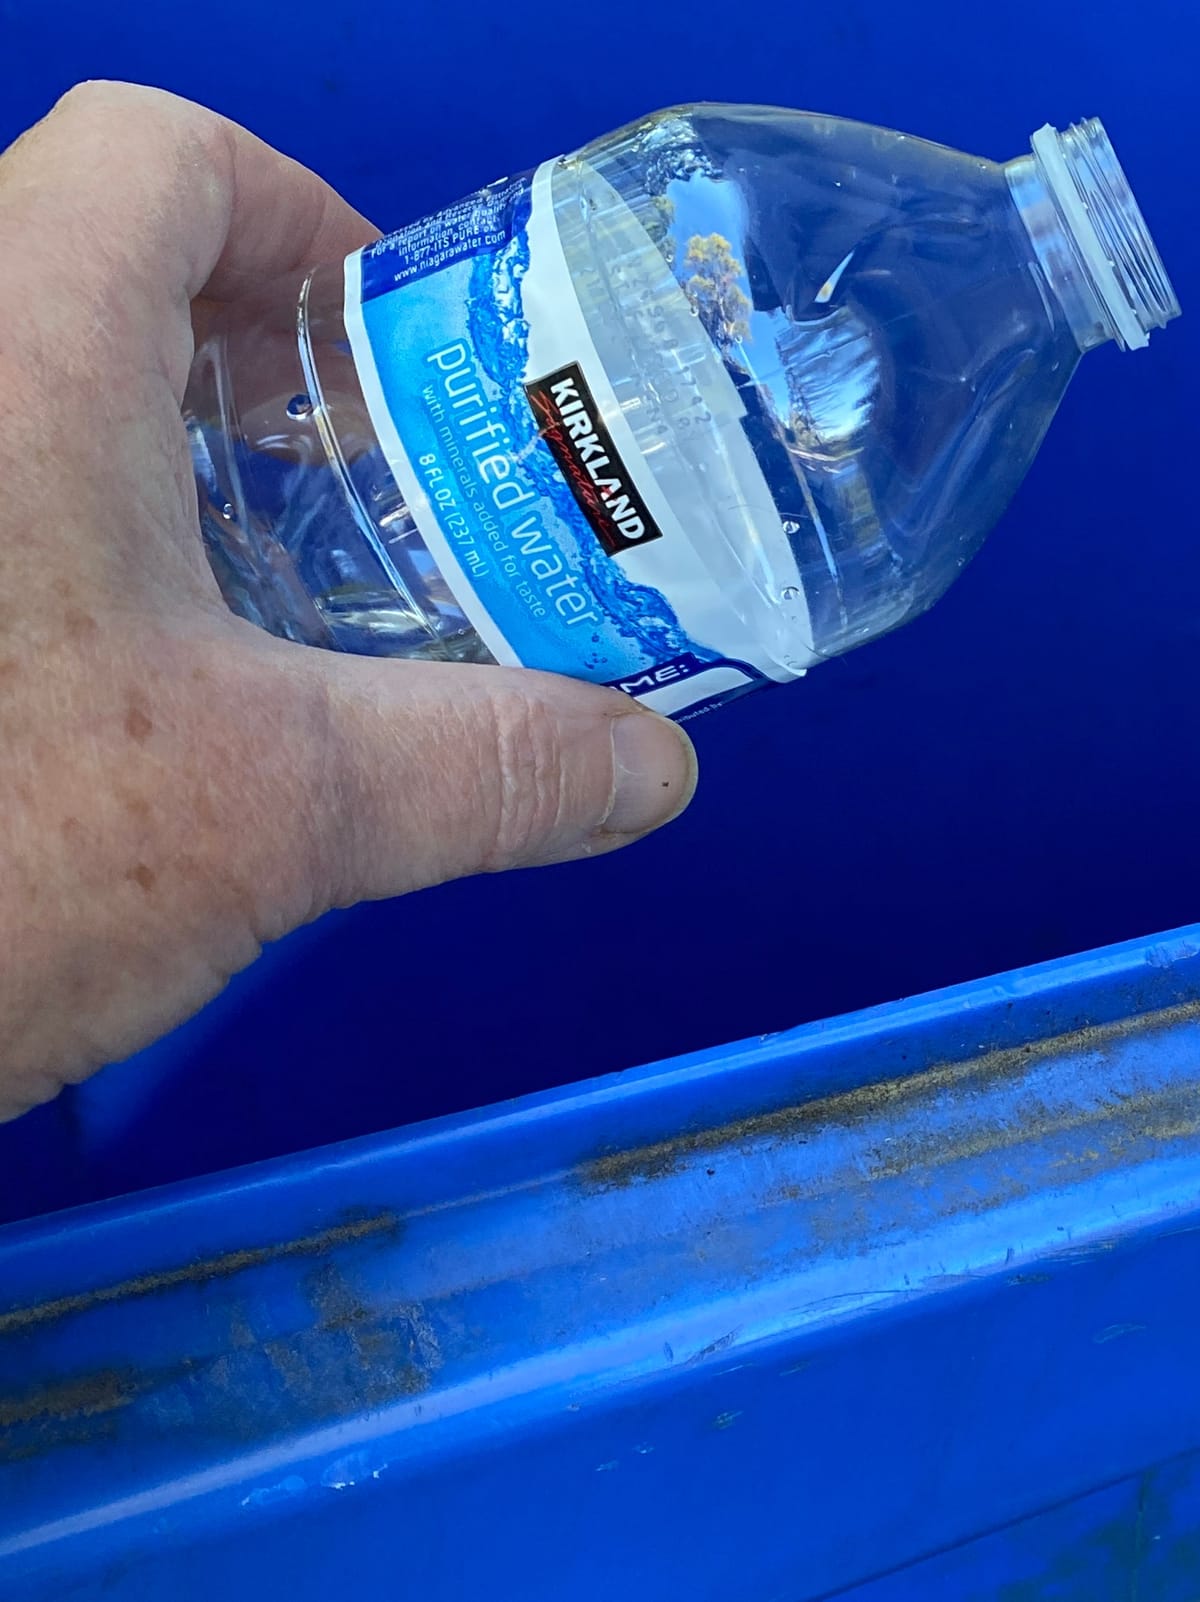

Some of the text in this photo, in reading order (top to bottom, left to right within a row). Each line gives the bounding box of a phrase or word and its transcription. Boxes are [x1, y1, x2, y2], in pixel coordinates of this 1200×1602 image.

[371, 244, 387, 259] For
[398, 229, 427, 246] report
[429, 224, 442, 234] on
[445, 212, 472, 228] water
[452, 225, 479, 243] PURE
[418, 453, 490, 579] 8 FL OZ (237 mL)
[422, 384, 546, 618] with minerals added for taste
[427, 343, 598, 624] purified water
[550, 377, 645, 540] KIRKLAND
[609, 664, 689, 693] ME:
